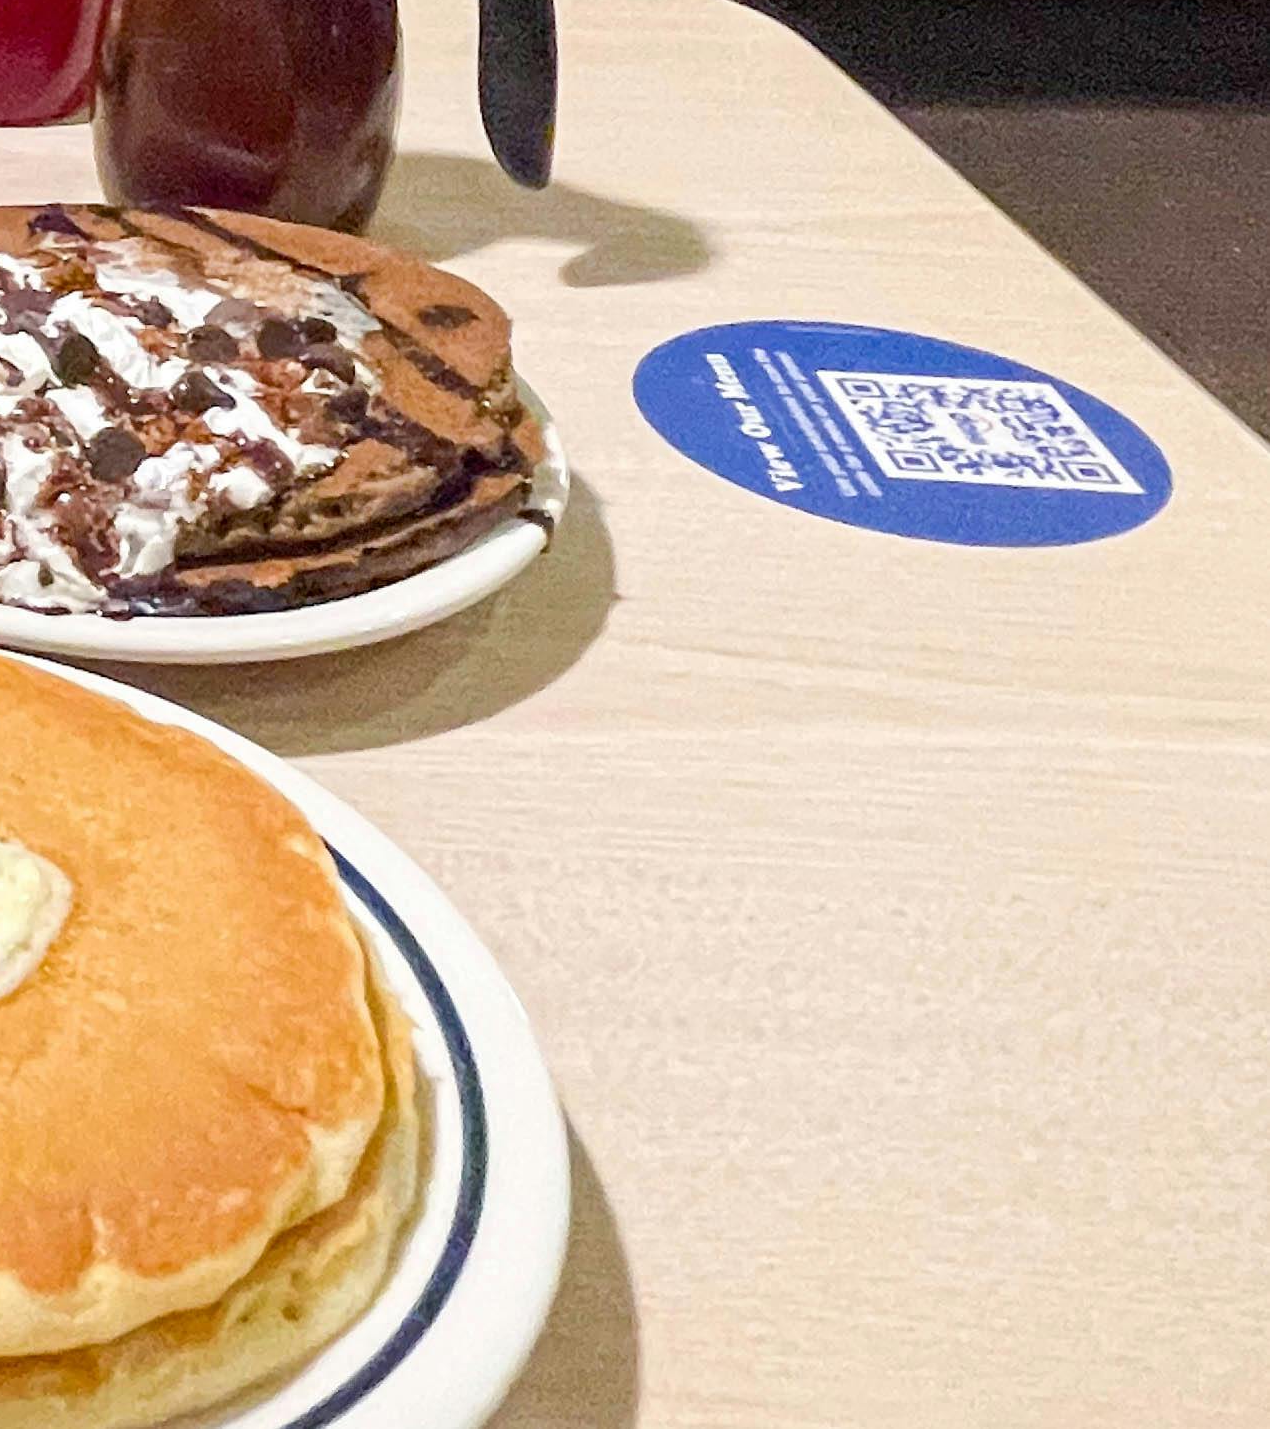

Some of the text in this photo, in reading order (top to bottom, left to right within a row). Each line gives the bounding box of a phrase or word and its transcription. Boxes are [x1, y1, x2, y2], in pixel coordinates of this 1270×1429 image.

[706, 353, 804, 493] View Our Menu
